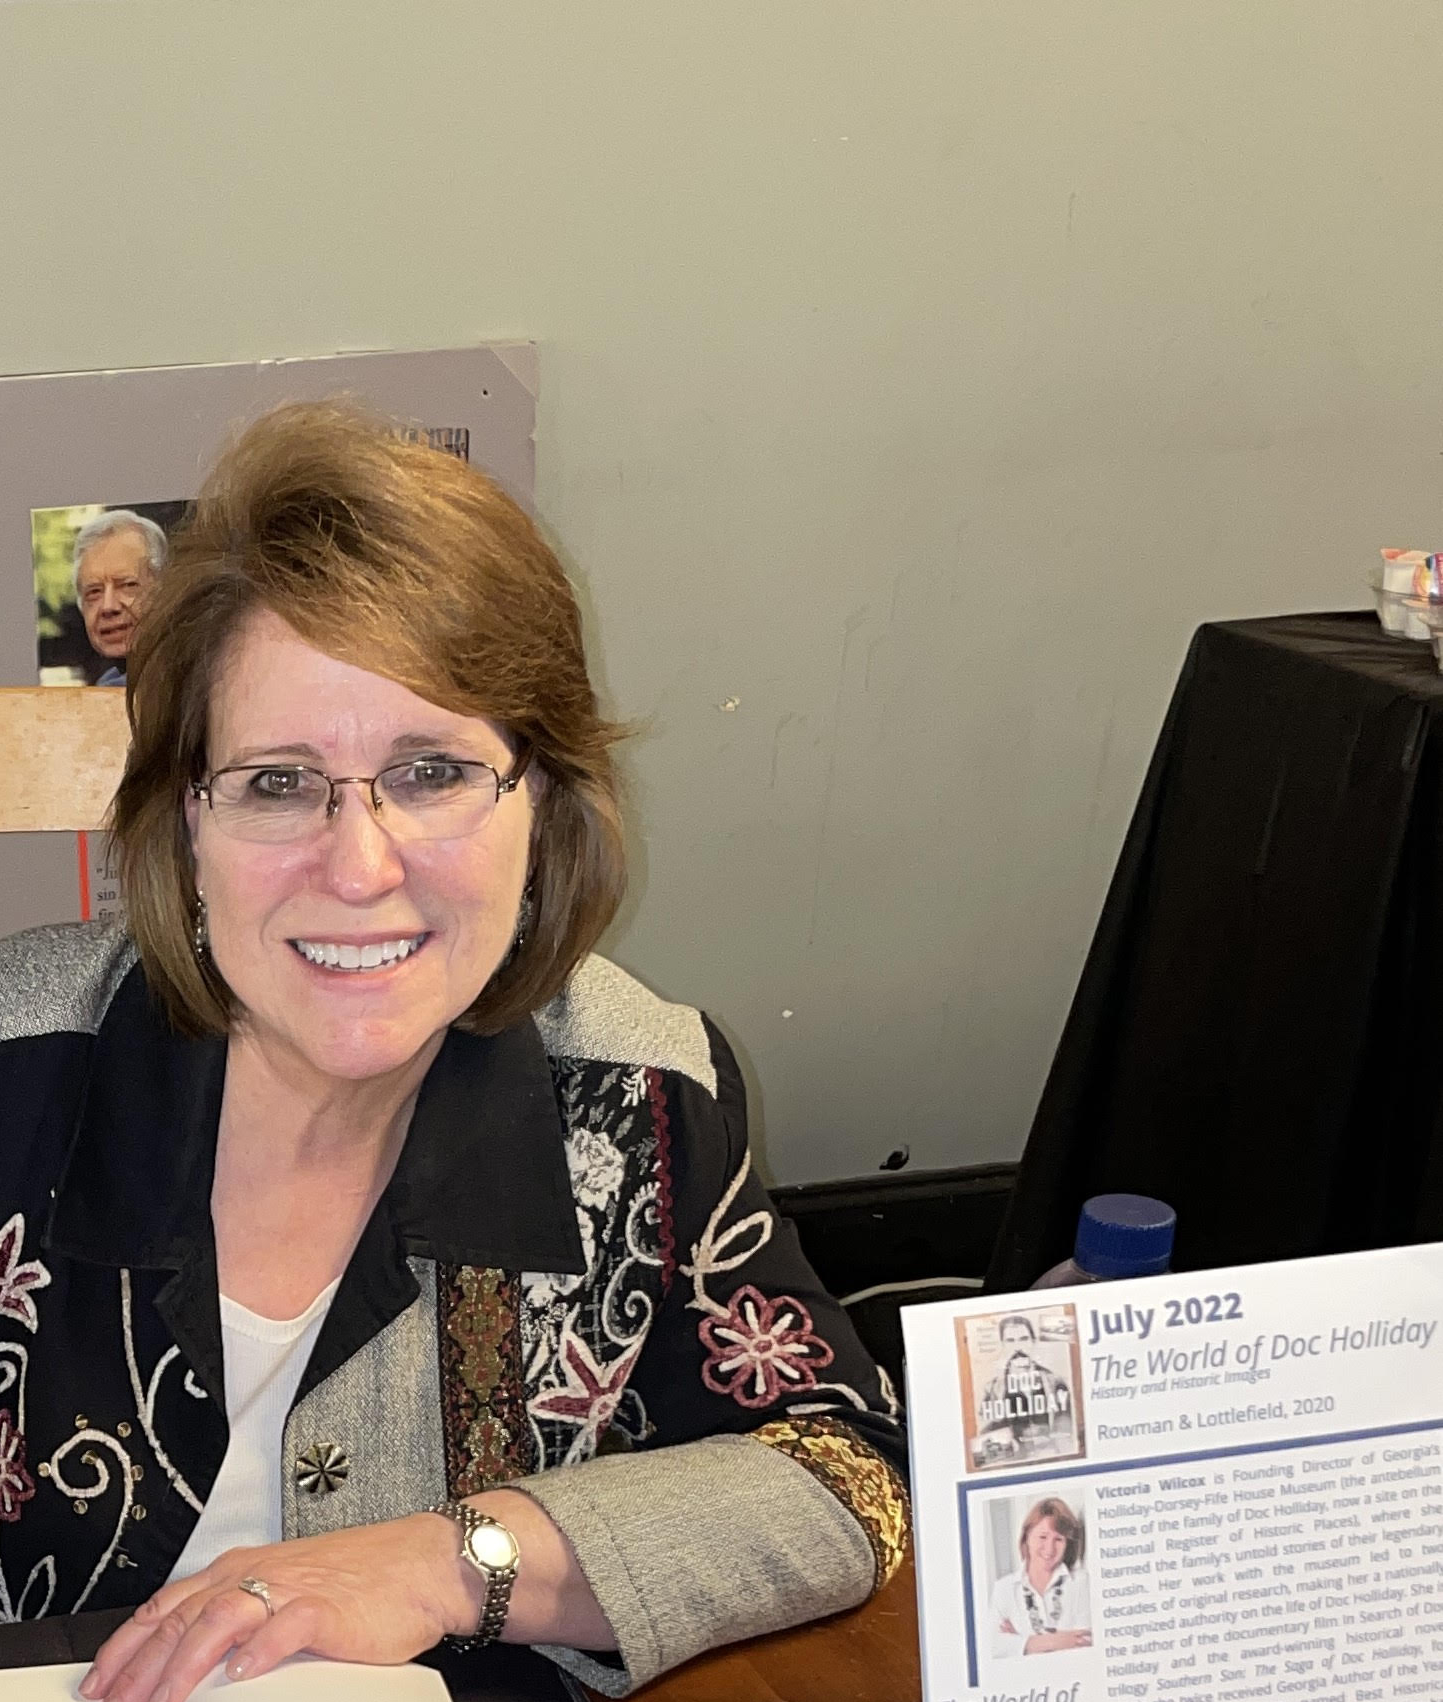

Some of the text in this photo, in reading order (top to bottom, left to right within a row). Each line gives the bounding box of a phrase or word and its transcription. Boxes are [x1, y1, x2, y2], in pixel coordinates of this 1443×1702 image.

[1089, 1292, 1243, 1345] July 2022
[1092, 1317, 1438, 1382] The World of Doc Holliday
[980, 1388, 1070, 1421] HOLLIDAY
[1008, 1370, 1042, 1394] DOC
[1091, 1367, 1271, 1400] History and Historic Images
[1098, 1417, 1173, 1440] Rowman
[1178, 1415, 1192, 1430] &
[1292, 1395, 1335, 1415] 2020
[1096, 1443, 1441, 1500] Victoria Wilcox is Founding Director of Georgia's
